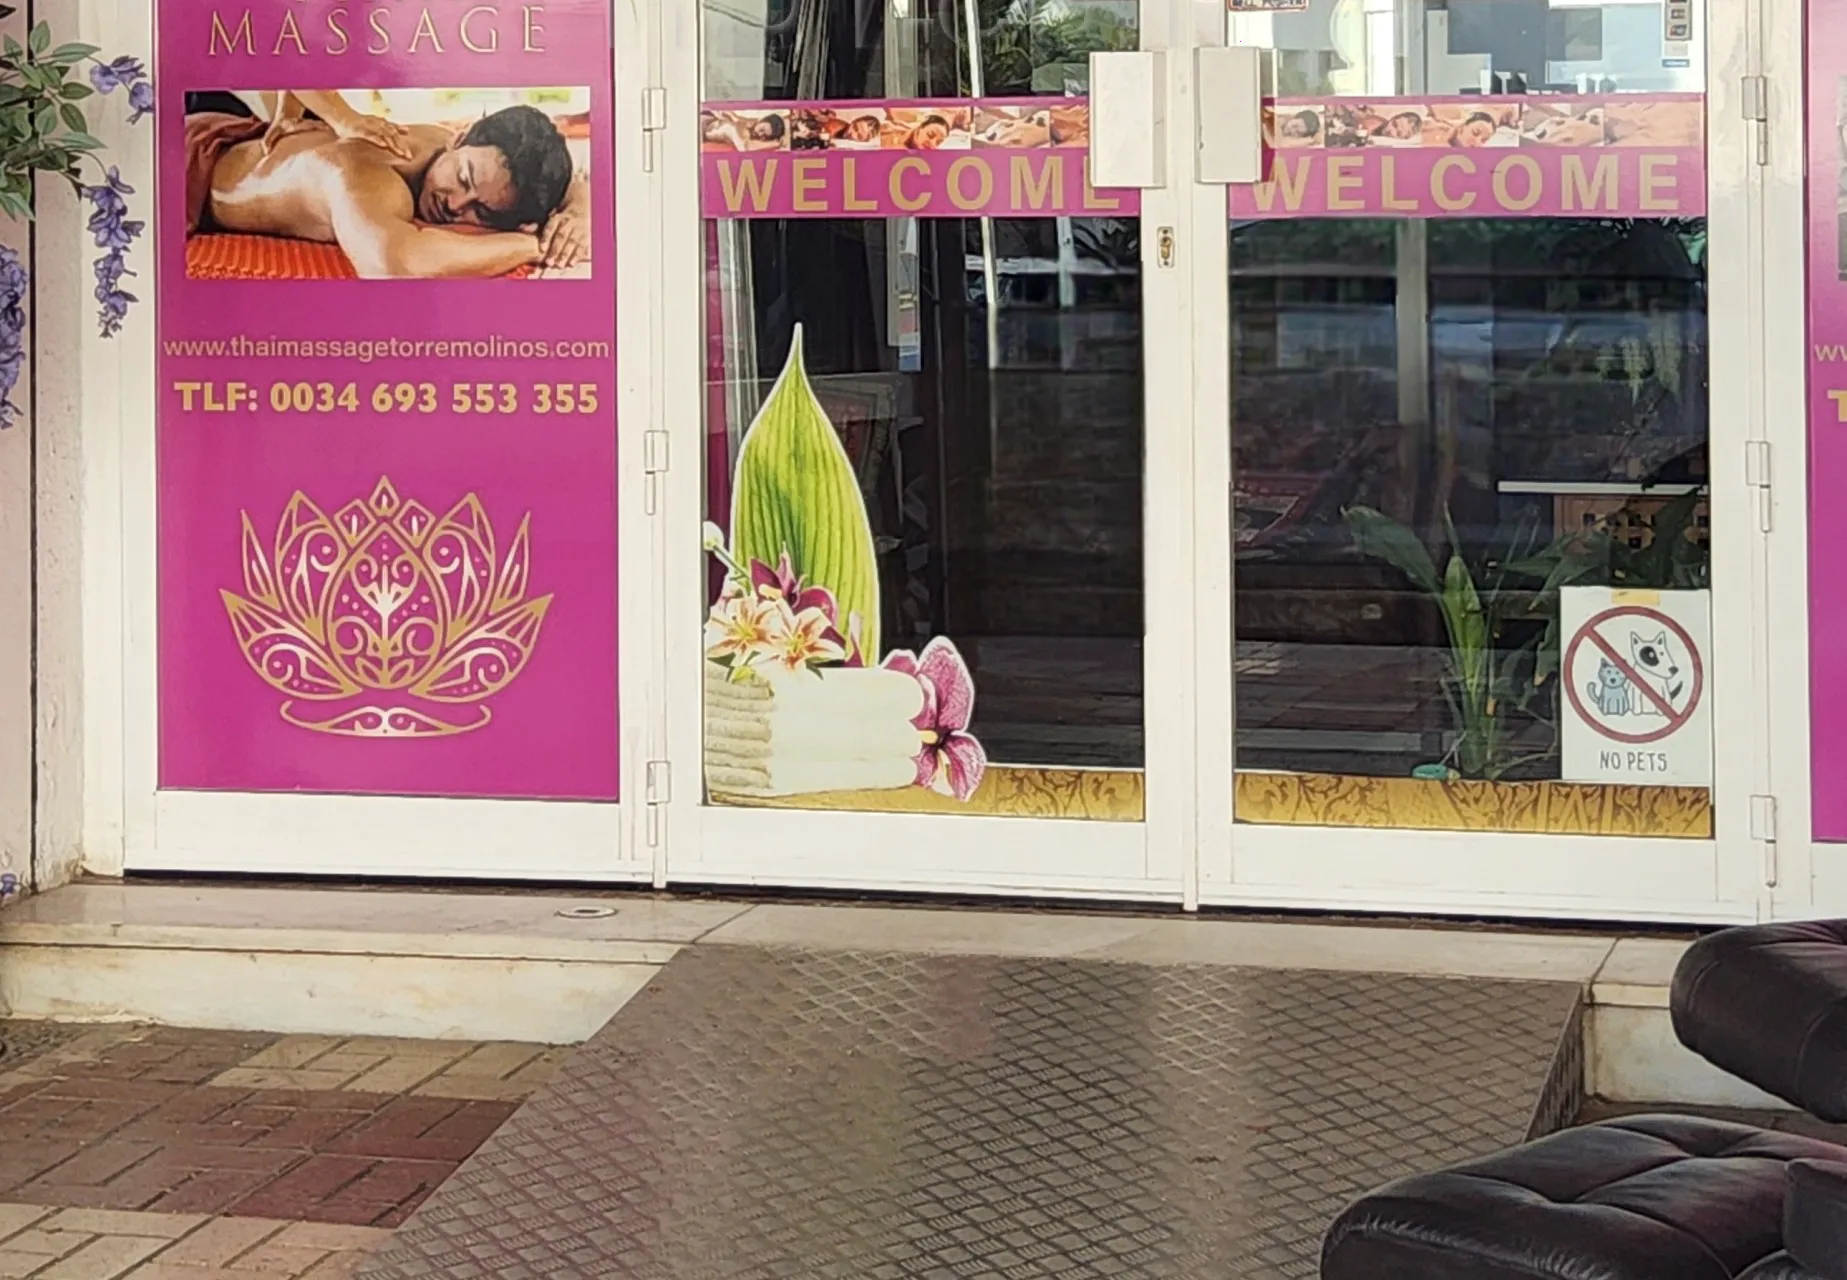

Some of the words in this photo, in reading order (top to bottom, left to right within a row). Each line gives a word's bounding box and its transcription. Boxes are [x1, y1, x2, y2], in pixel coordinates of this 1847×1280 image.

[208, 6, 546, 56] MASSAGE
[163, 334, 609, 363] www.thaimassagetorremolinos.com
[174, 381, 258, 412] TLF:
[270, 381, 360, 413] 0034
[371, 381, 438, 413] 693
[452, 382, 518, 414] 553
[532, 383, 598, 414] 355
[1600, 750, 1621, 771] NO
[1627, 751, 1668, 772] PETS
